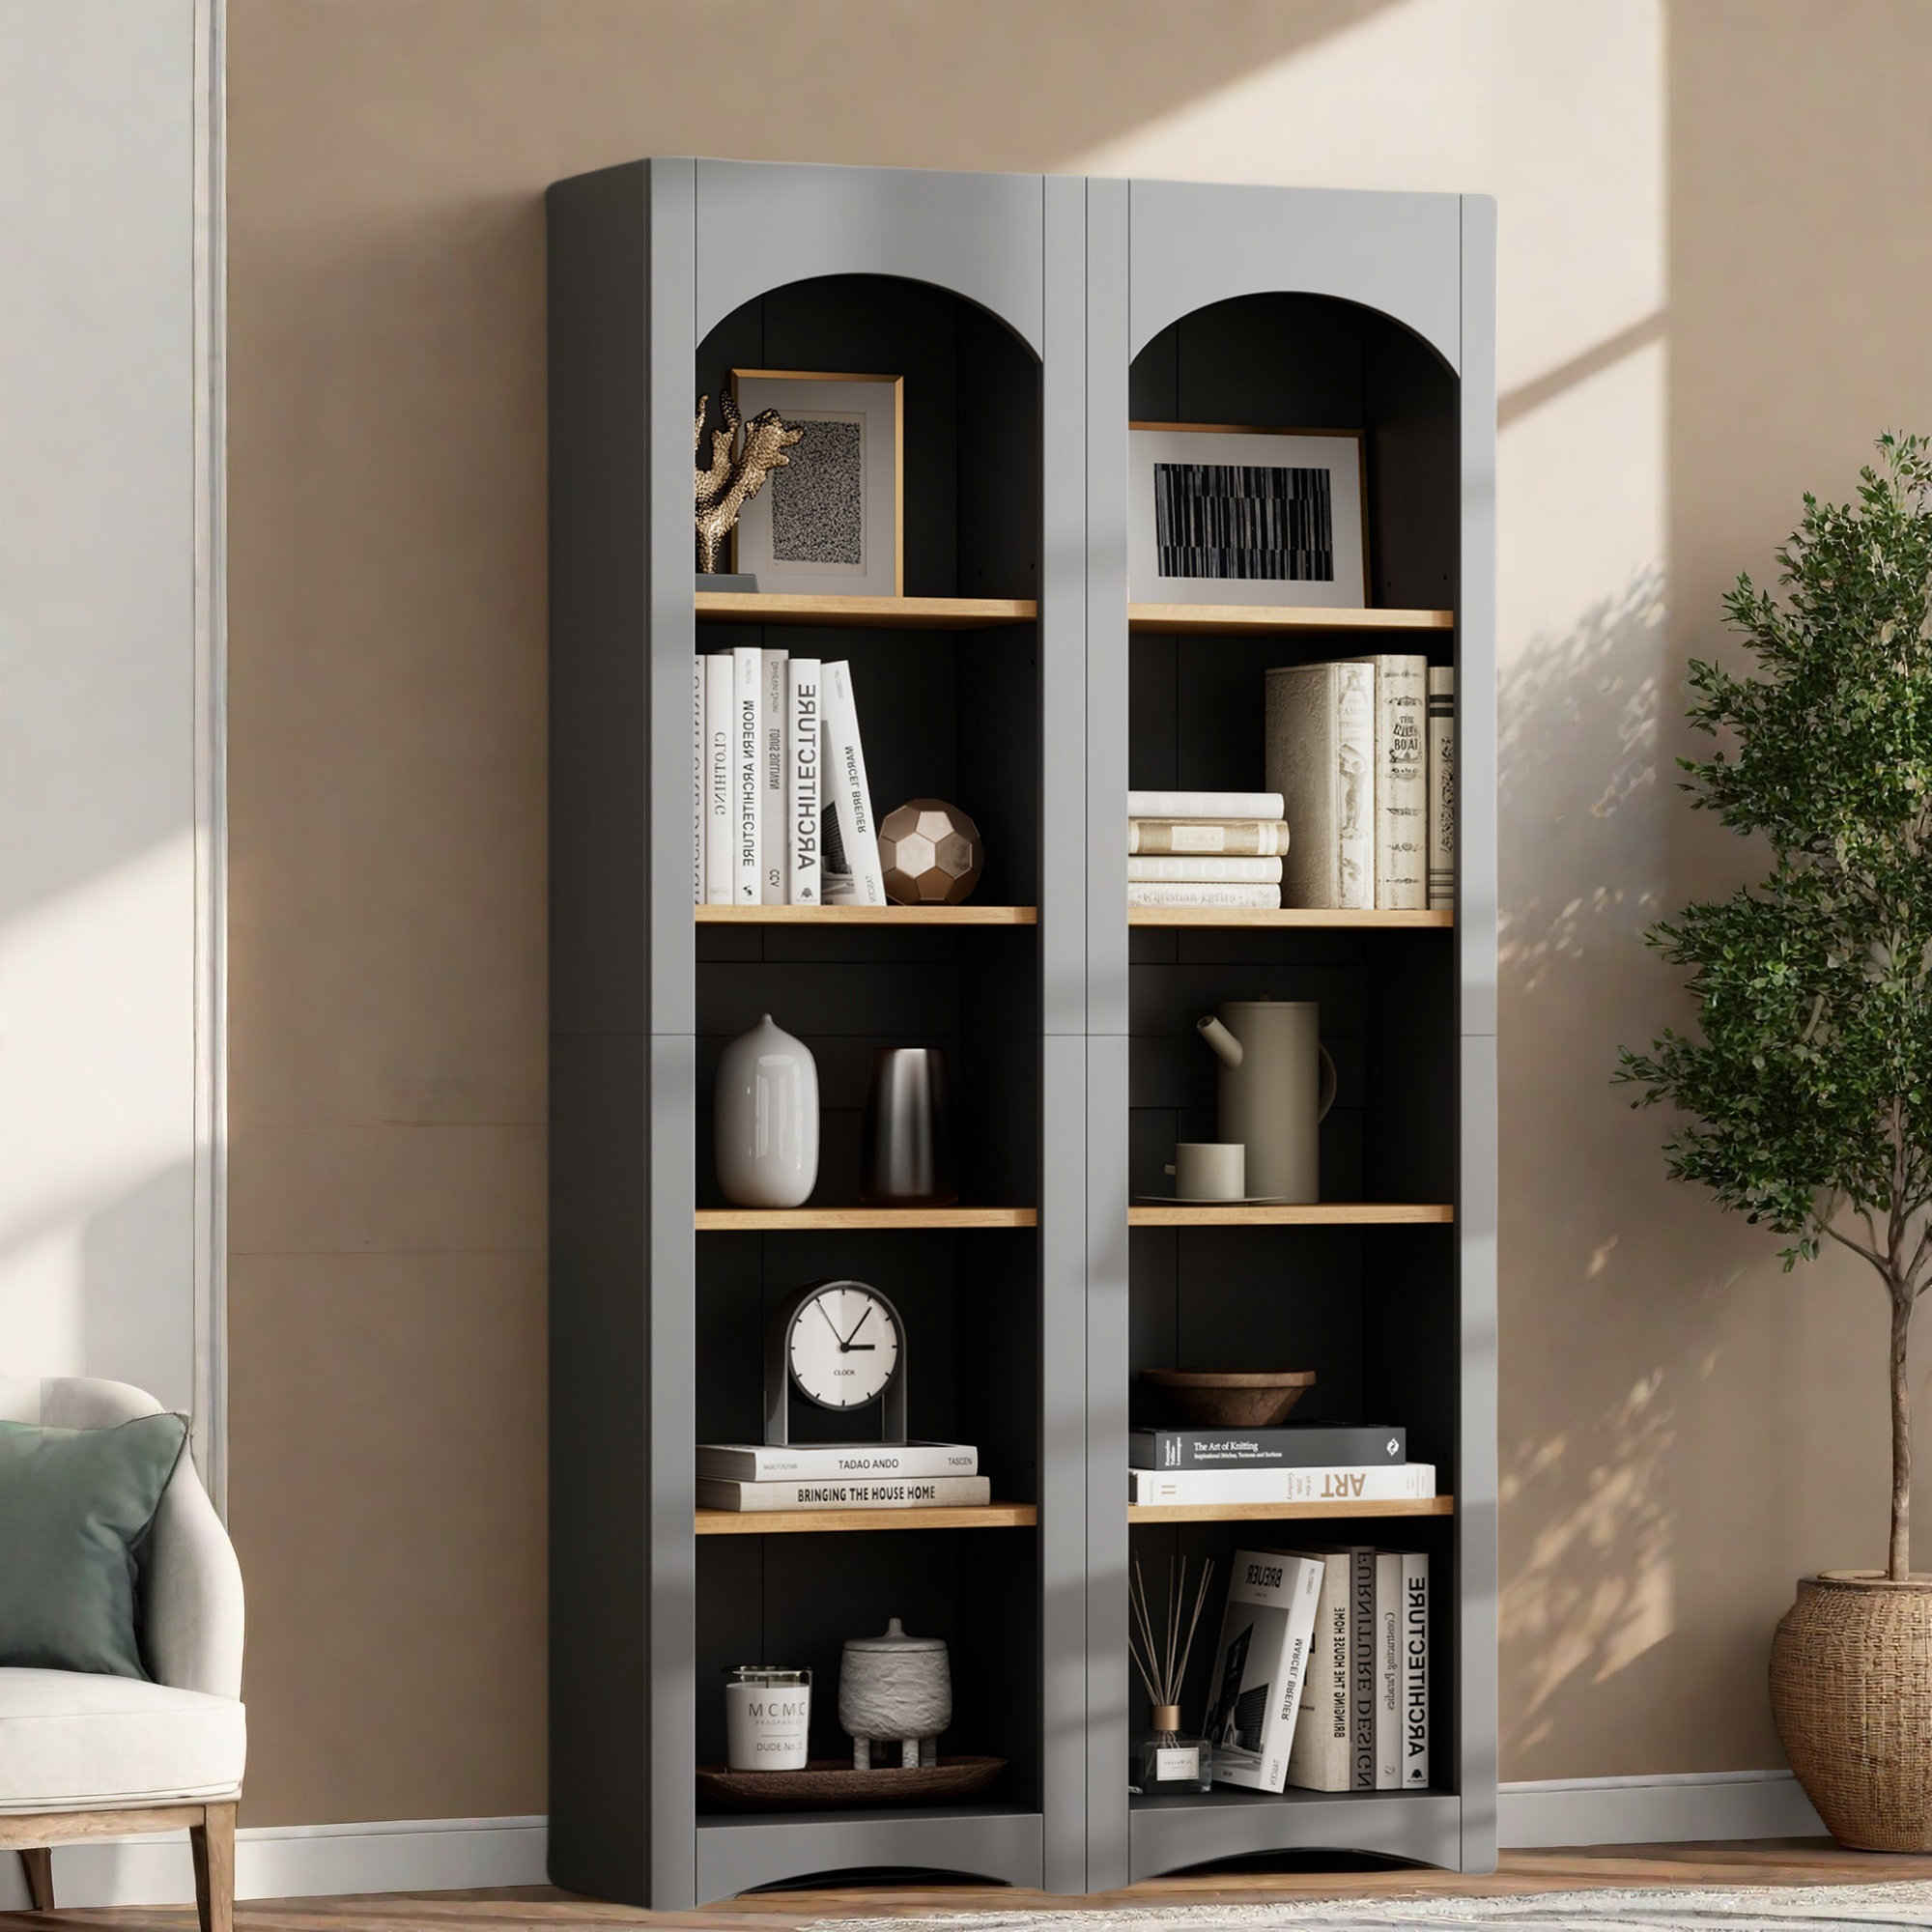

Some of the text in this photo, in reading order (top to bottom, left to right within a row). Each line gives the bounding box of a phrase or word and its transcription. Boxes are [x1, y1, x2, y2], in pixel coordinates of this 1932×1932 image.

[1399, 715, 1414, 724] THE
[1394, 738, 1419, 751] BOAT
[1194, 1441, 1259, 1453] The Art of Knitting
[838, 1459, 899, 1470] TADAO ANDO
[1320, 1473, 1367, 1497] ART
[798, 1486, 935, 1503] BRINGING THE HOUSE HOME
[756, 1742, 781, 1751] DUDE
